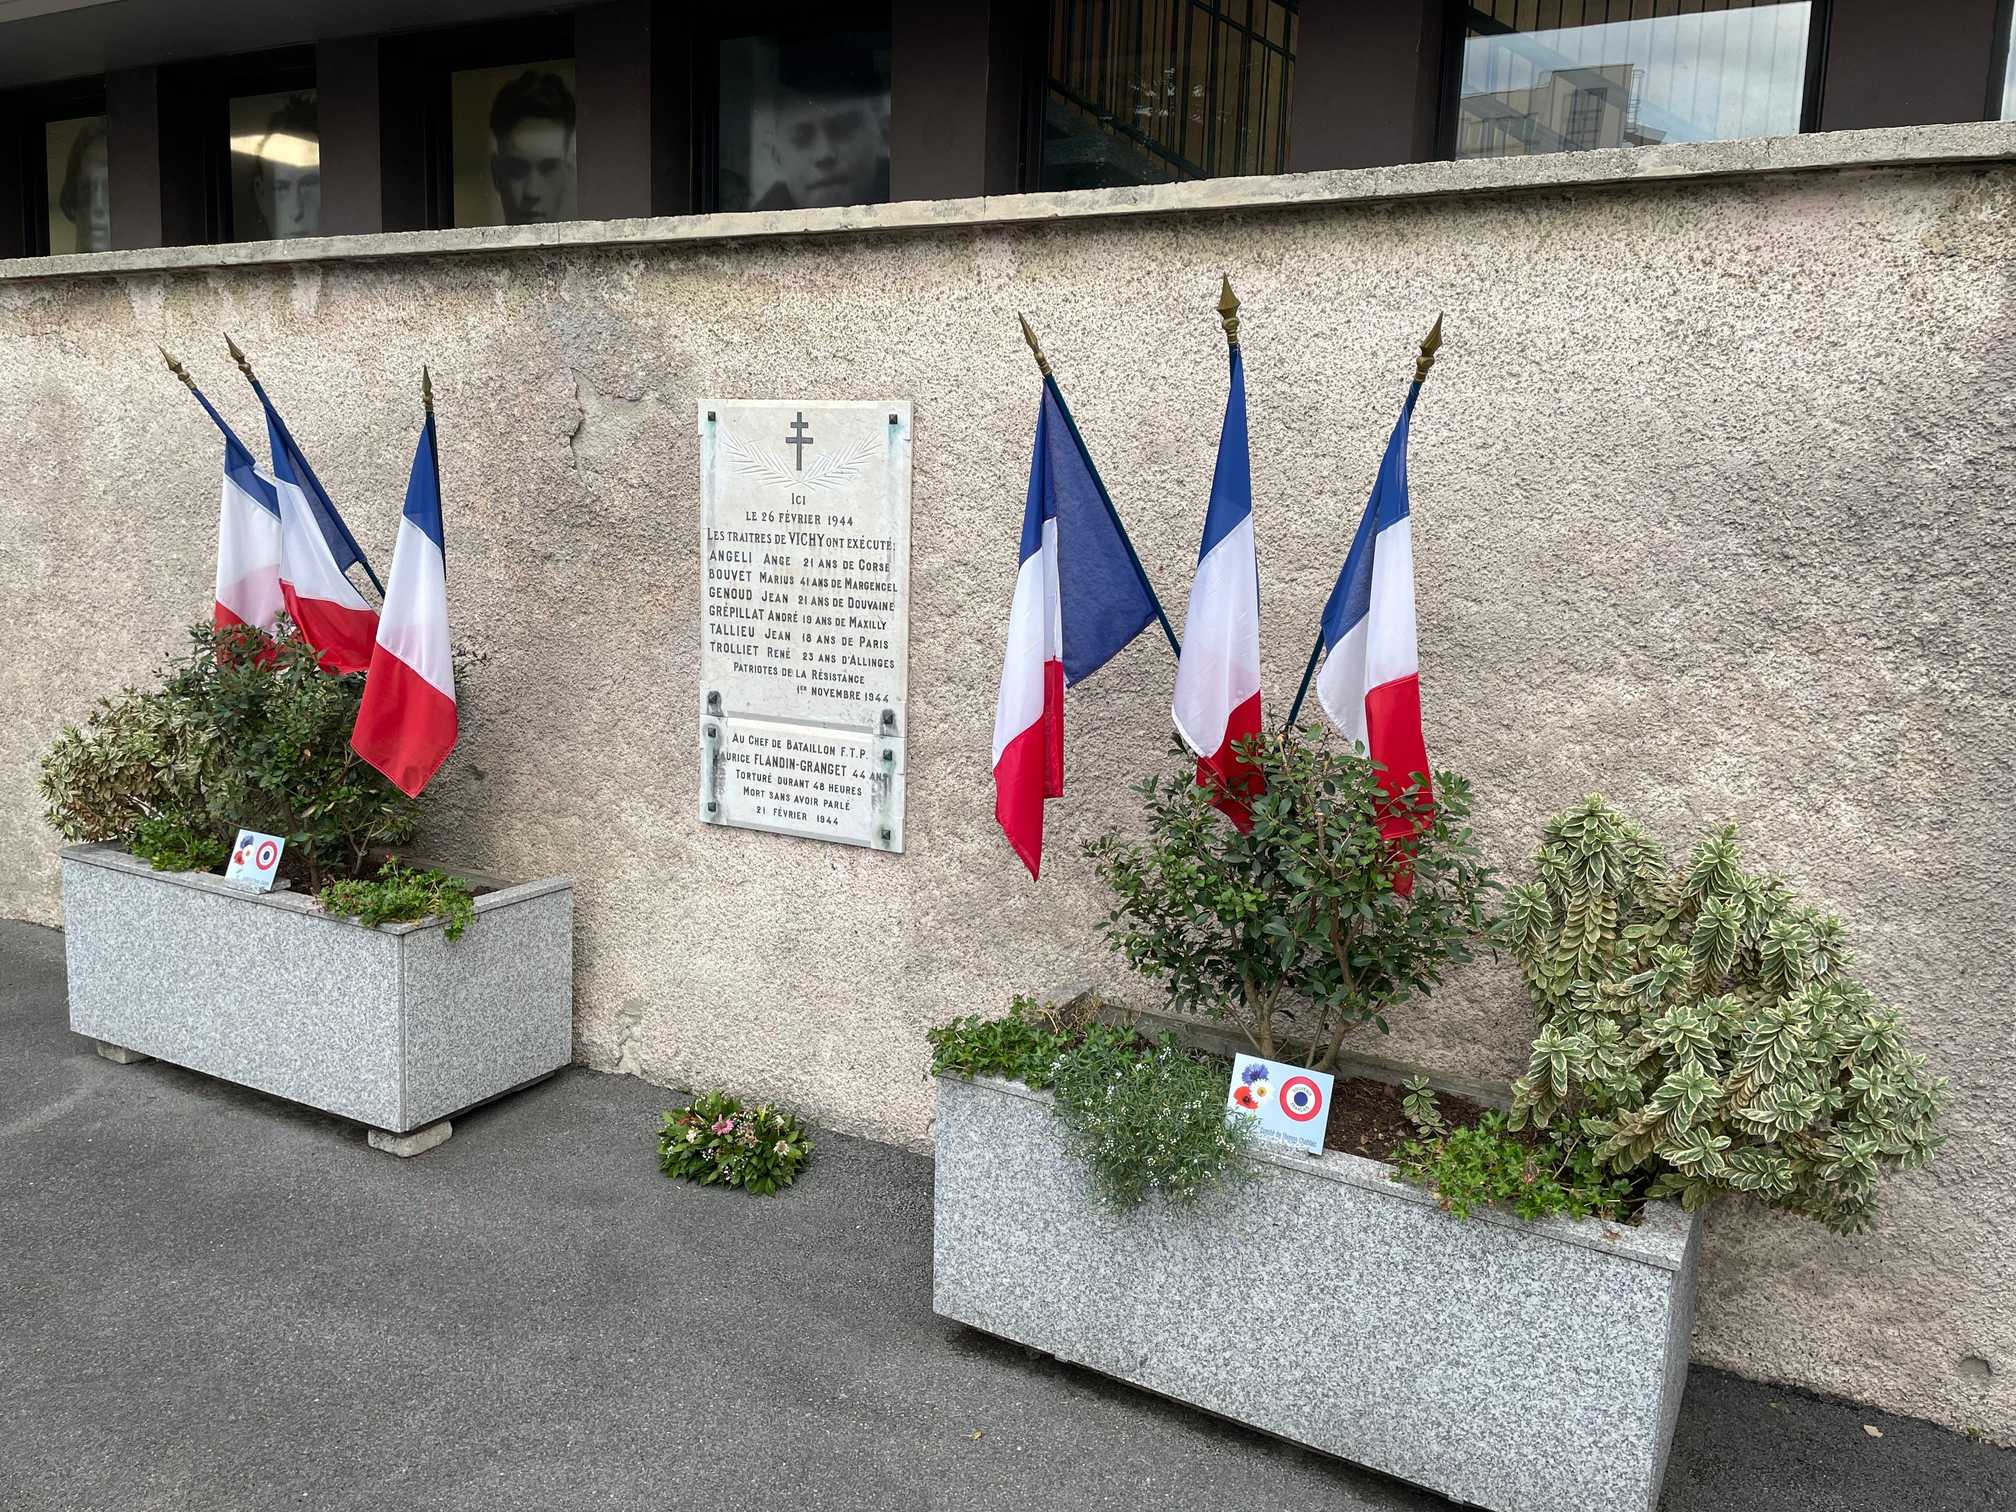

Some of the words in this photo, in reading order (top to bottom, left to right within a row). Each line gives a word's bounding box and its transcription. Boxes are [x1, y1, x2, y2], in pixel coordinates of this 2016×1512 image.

[746, 511, 757, 521] LE
[762, 511, 775, 522] 26
[779, 509, 821, 525] FÉVRIER
[828, 515, 853, 527] 1944
[727, 531, 772, 544] TRAITRES
[774, 534, 786, 544] DE
[788, 532, 825, 547] VICHY
[826, 537, 845, 548] ONT
[709, 549, 752, 563] ANGELI
[803, 558, 814, 568] 21
[818, 559, 838, 569] ANS
[842, 560, 854, 570] DE
[709, 568, 752, 582] BOUVET
[800, 576, 809, 587] 41
[811, 578, 829, 588] ANS
[831, 579, 842, 589] DE
[709, 586, 752, 601] GENOUD
[798, 595, 807, 605] 21
[810, 596, 830, 607] ANS
[832, 598, 844, 608] DE
[709, 602, 764, 620] GRÉPILLAT
[815, 616, 832, 626] ANS
[835, 617, 846, 627] DE
[709, 623, 755, 638] TALLIEU
[802, 633, 812, 643] 18
[816, 634, 836, 645] ANS
[841, 636, 853, 646] DE
[709, 641, 759, 657] TROLLIET
[802, 652, 814, 661] 23
[818, 653, 836, 663] ANS
[782, 668, 792, 677] DE
[795, 669, 807, 679] LA
[811, 686, 861, 700] NOVEMBRE
[864, 692, 889, 703] 1944
[771, 739, 781, 749] DE
[754, 754, 847, 777] FLANDIN-GRANGET
[852, 769, 866, 779] 44
[777, 776, 810, 788] DURANT
[813, 781, 825, 791] 48
[828, 784, 862, 796] HEURES
[769, 791, 791, 802] SANS
[793, 795, 819, 807] AVOIR
[823, 799, 851, 811] PARLÉ
[756, 806, 766, 815] 21
[773, 806, 807, 821] FÉVRIER
[816, 814, 839, 825] 1944
